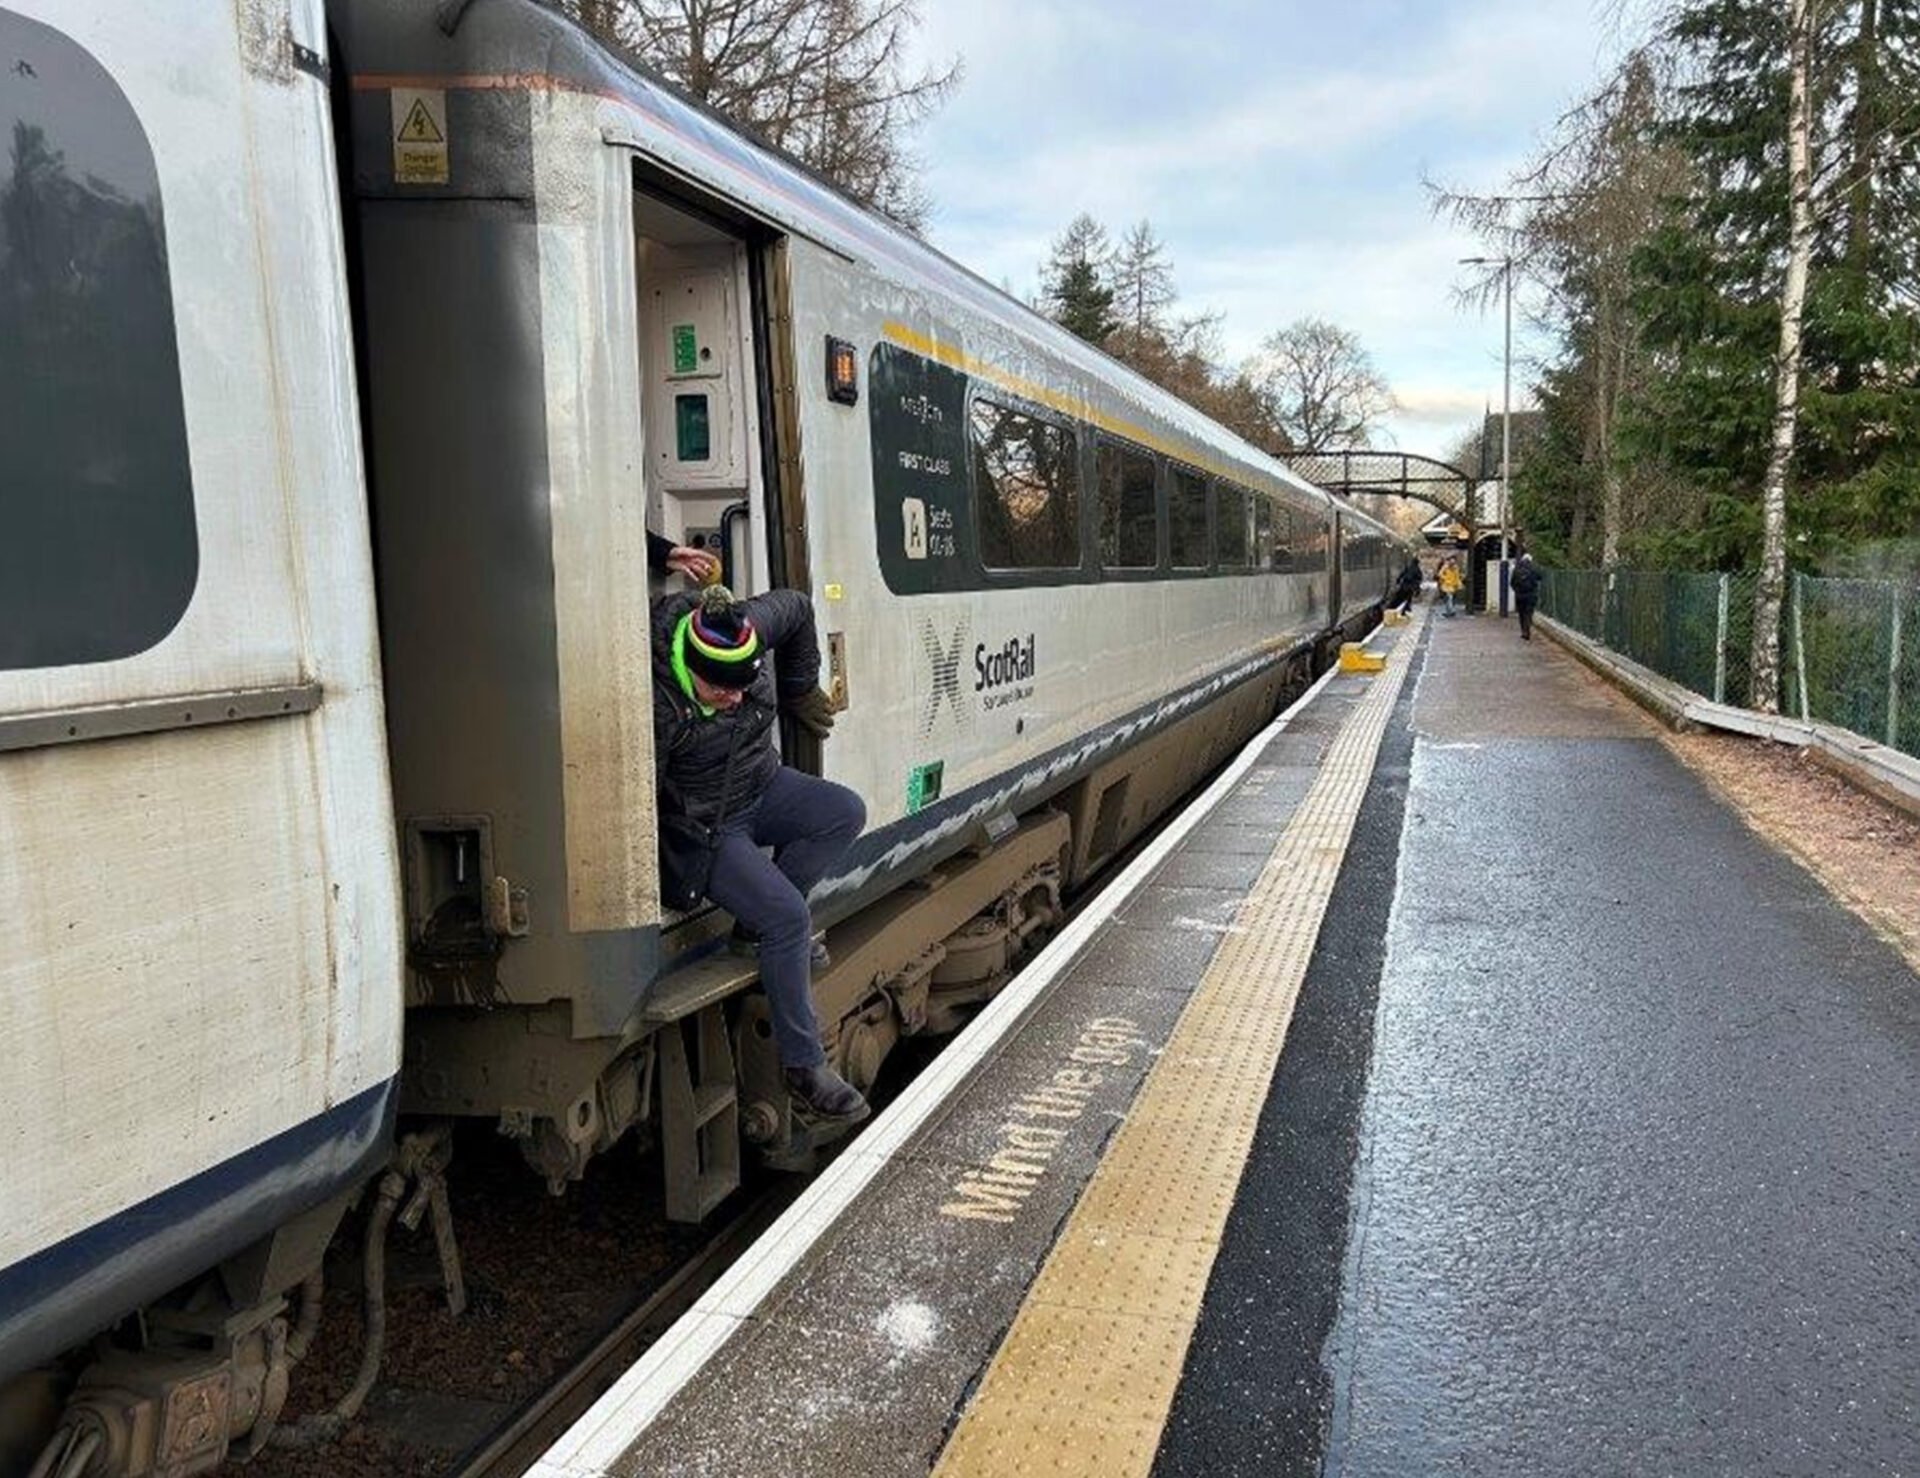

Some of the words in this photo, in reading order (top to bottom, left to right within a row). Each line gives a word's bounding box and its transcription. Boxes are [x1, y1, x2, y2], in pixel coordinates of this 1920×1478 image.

[899, 451, 922, 469] FIRST
[923, 456, 951, 476] CLASS
[911, 511, 921, 548] A
[975, 633, 1035, 692] ScotRail
[939, 1122, 1069, 1223] Mind
[1008, 1068, 1104, 1118] the
[1067, 1017, 1146, 1067] gap
